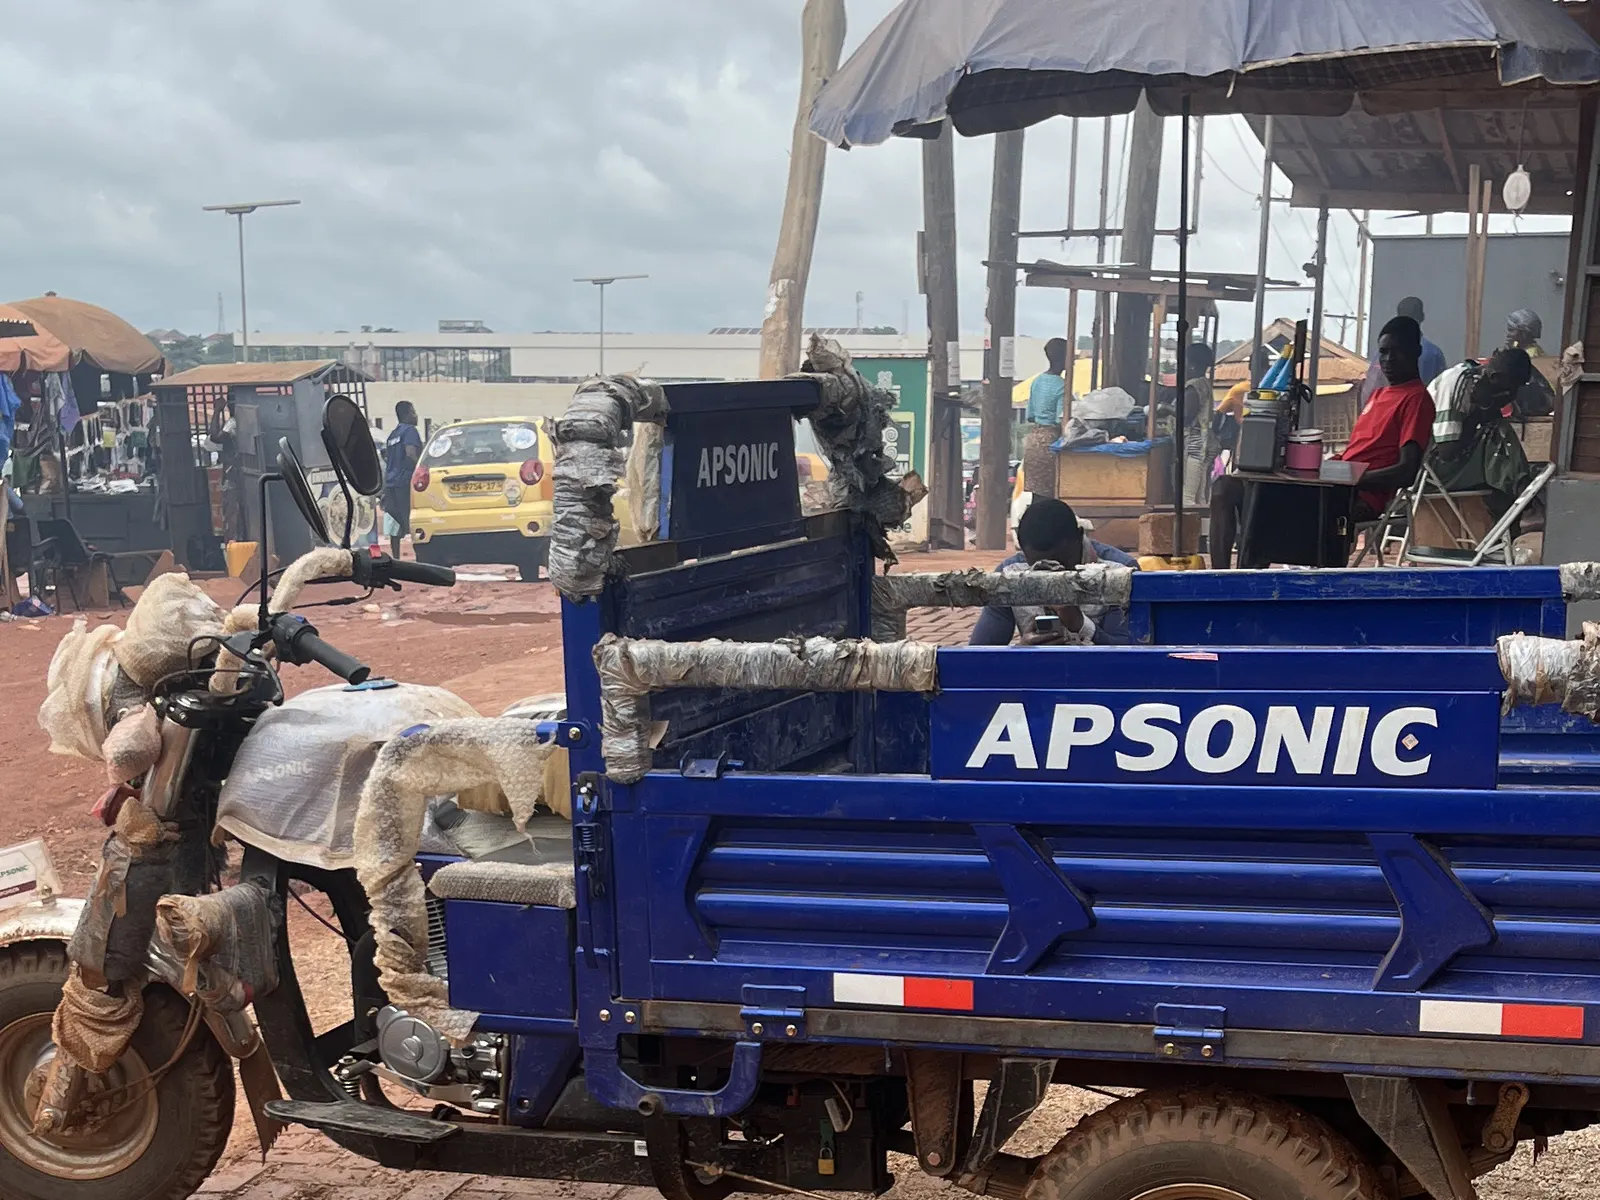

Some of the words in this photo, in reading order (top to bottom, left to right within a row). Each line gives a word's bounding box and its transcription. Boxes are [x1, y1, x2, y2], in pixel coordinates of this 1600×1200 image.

[696, 442, 779, 488] APSONIC
[965, 702, 1439, 776] APSONIC
[0, 864, 29, 878] PSONIC
